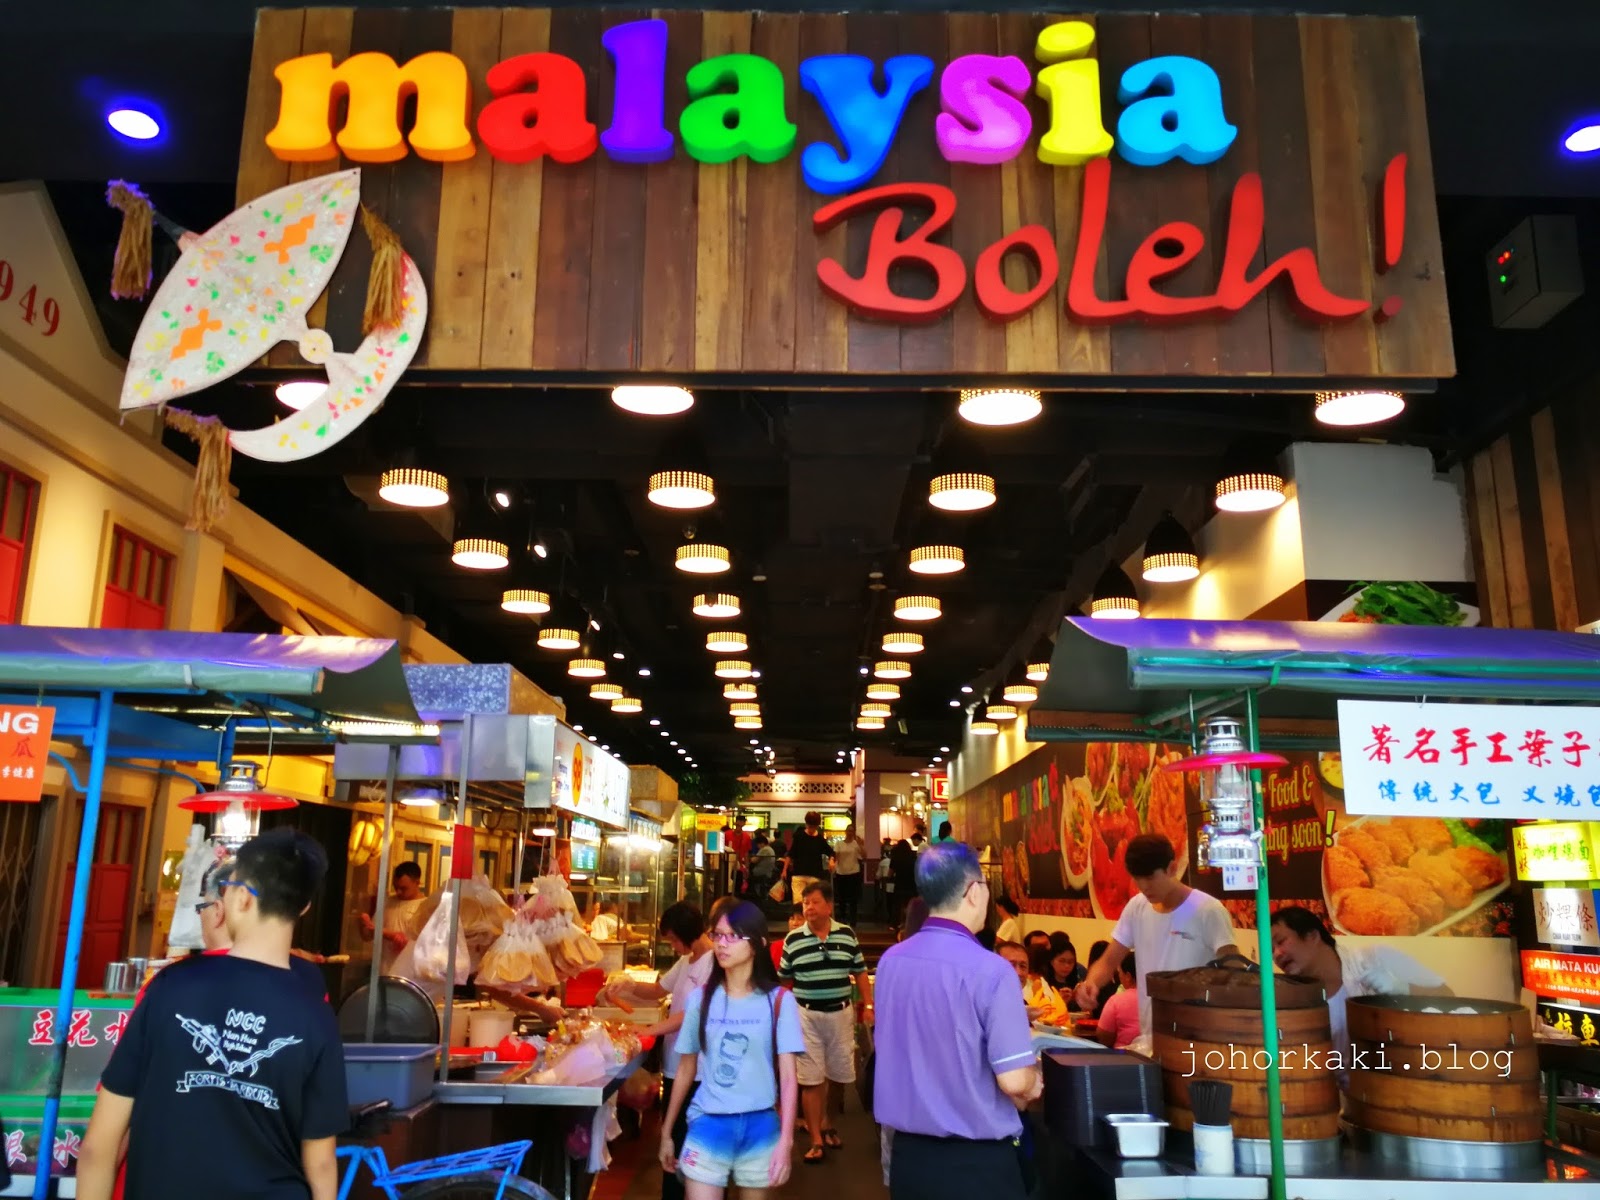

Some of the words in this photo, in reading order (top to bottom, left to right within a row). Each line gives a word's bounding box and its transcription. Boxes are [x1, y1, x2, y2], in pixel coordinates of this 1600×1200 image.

[265, 19, 1238, 194] malaysia
[813, 153, 1408, 325] Boleh!
[1363, 723, 1600, 768] 著名手工葉子
[1268, 769, 1300, 808] Food
[1533, 957, 1551, 969] AIR
[1552, 959, 1582, 973] MATA
[1583, 962, 1600, 974] KU
[222, 1029, 240, 1041] Nan
[240, 1033, 258, 1046] Hua
[225, 1008, 267, 1035] NCC
